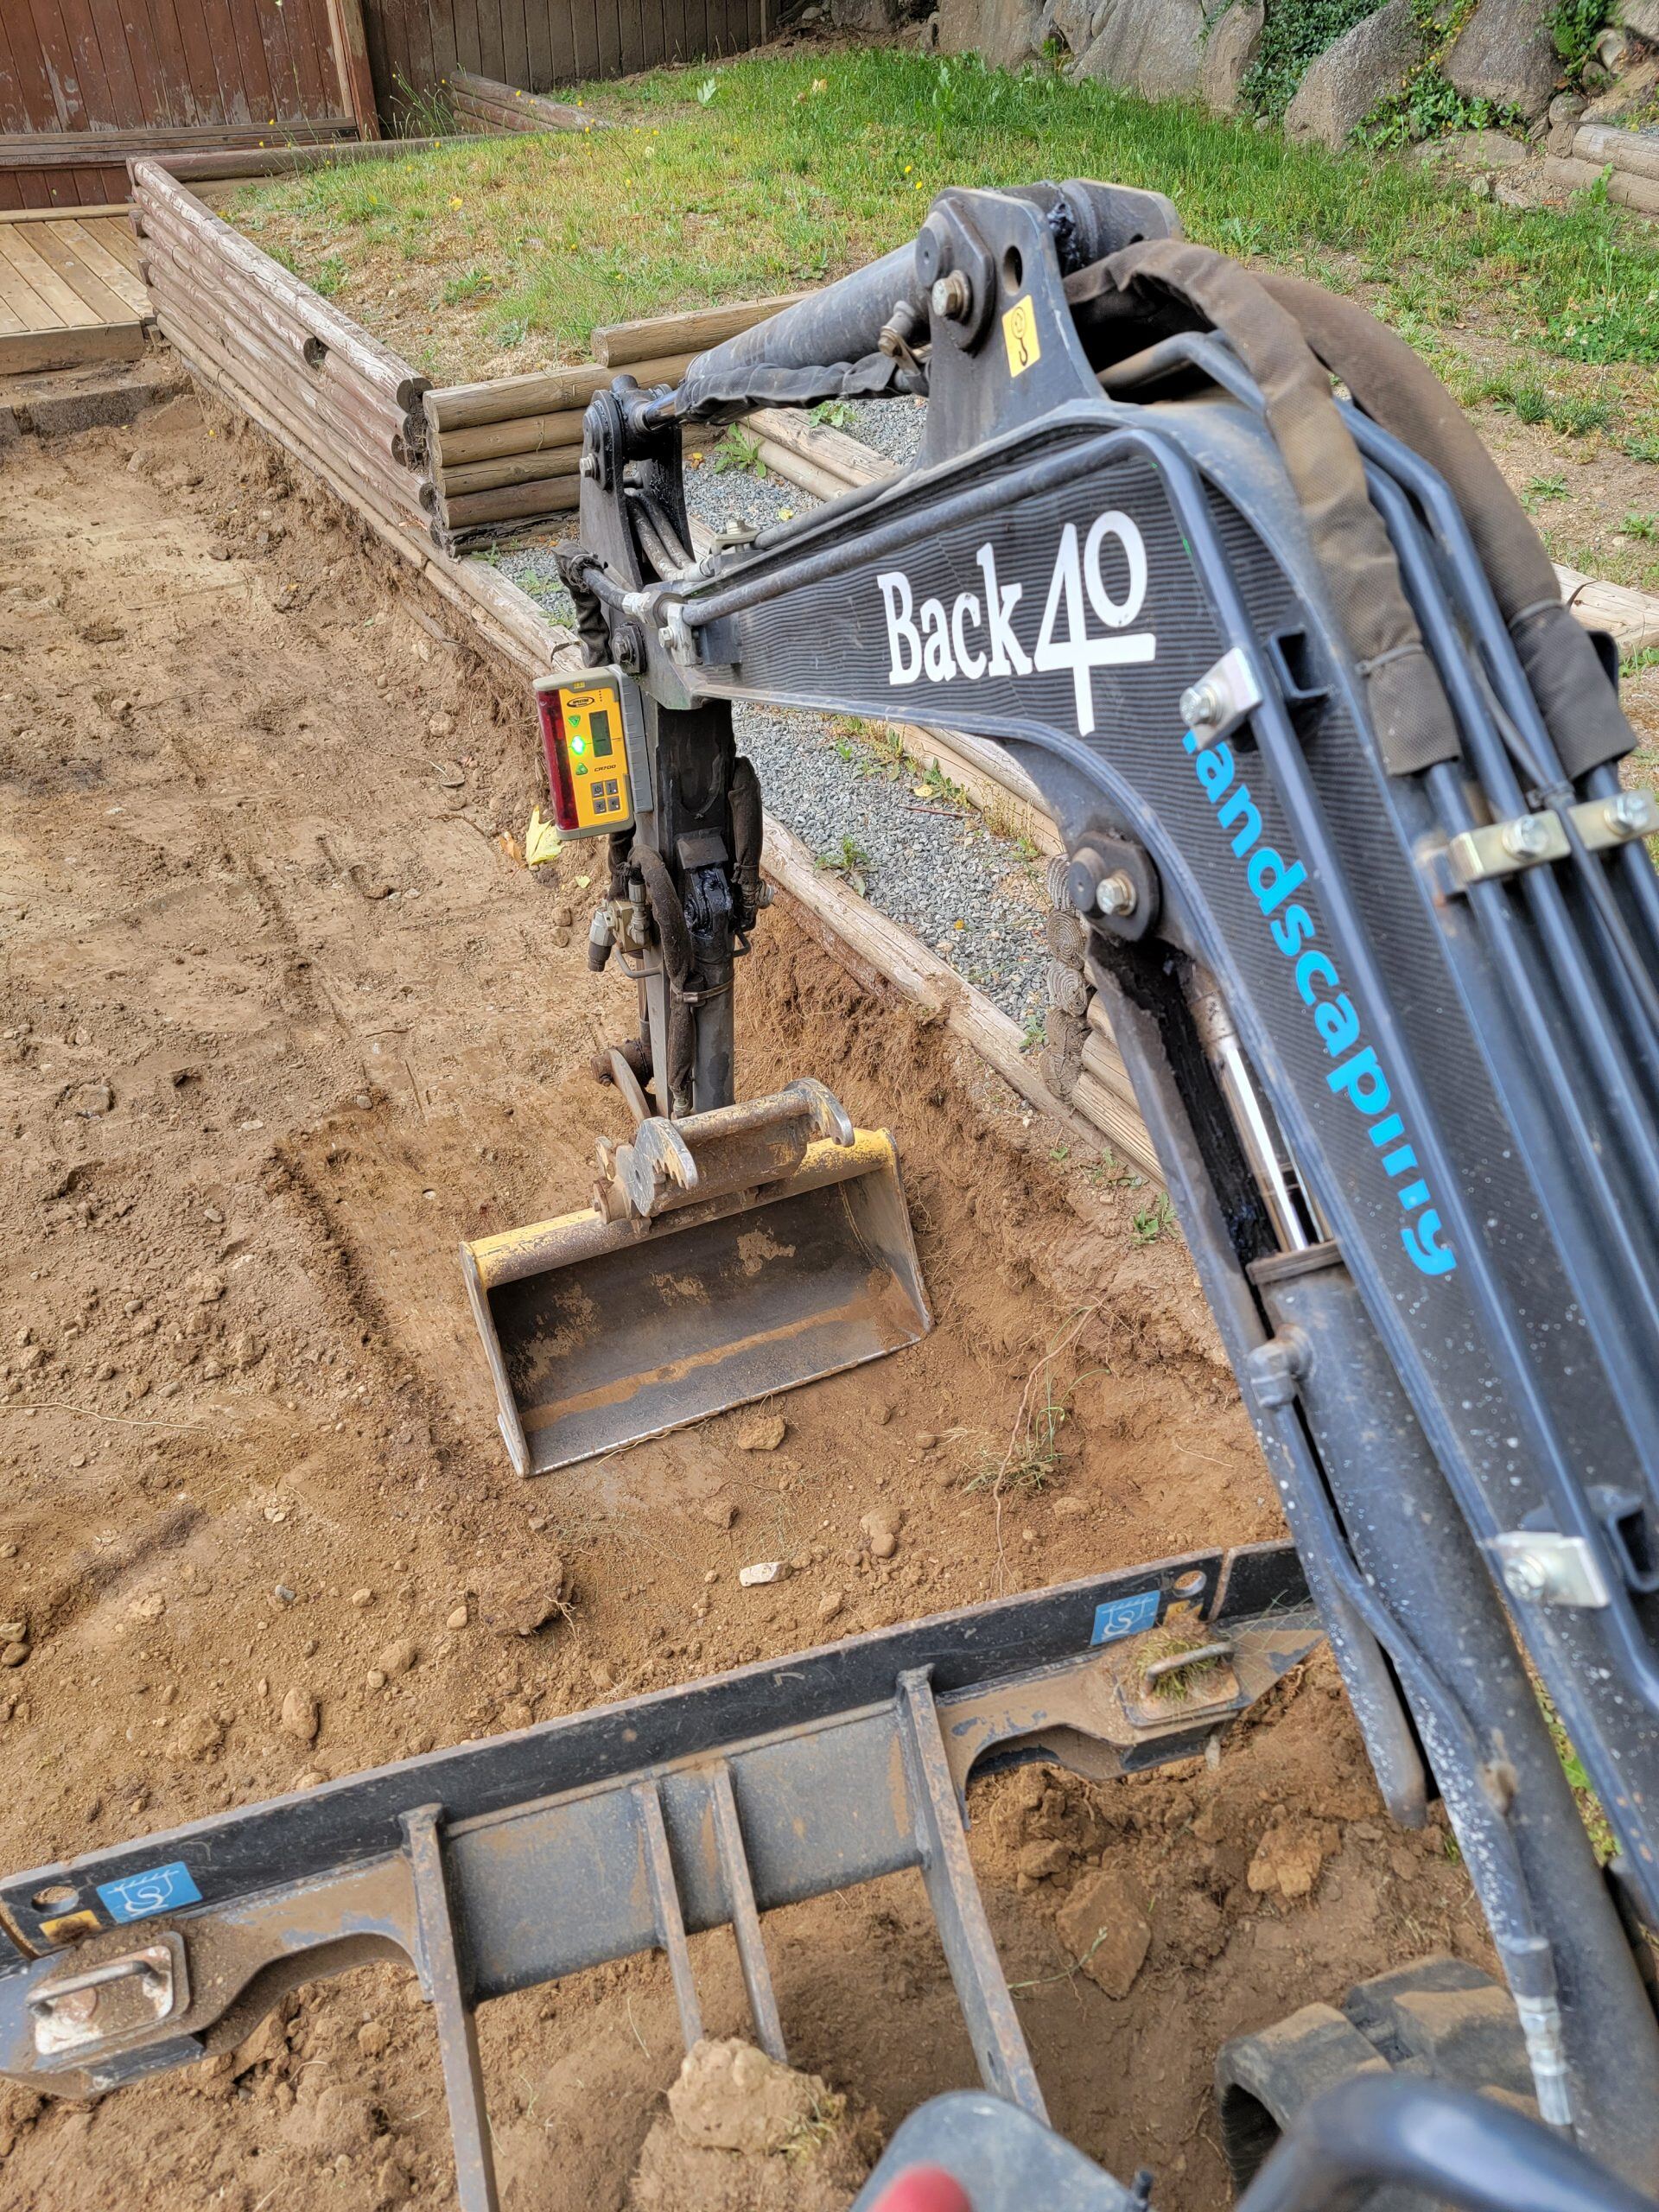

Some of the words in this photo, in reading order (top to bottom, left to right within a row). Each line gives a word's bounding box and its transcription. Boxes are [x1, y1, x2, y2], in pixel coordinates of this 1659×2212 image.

[876, 542, 1033, 685] Back
[594, 764, 617, 772] CR700
[1181, 728, 1458, 1276] andscaping
